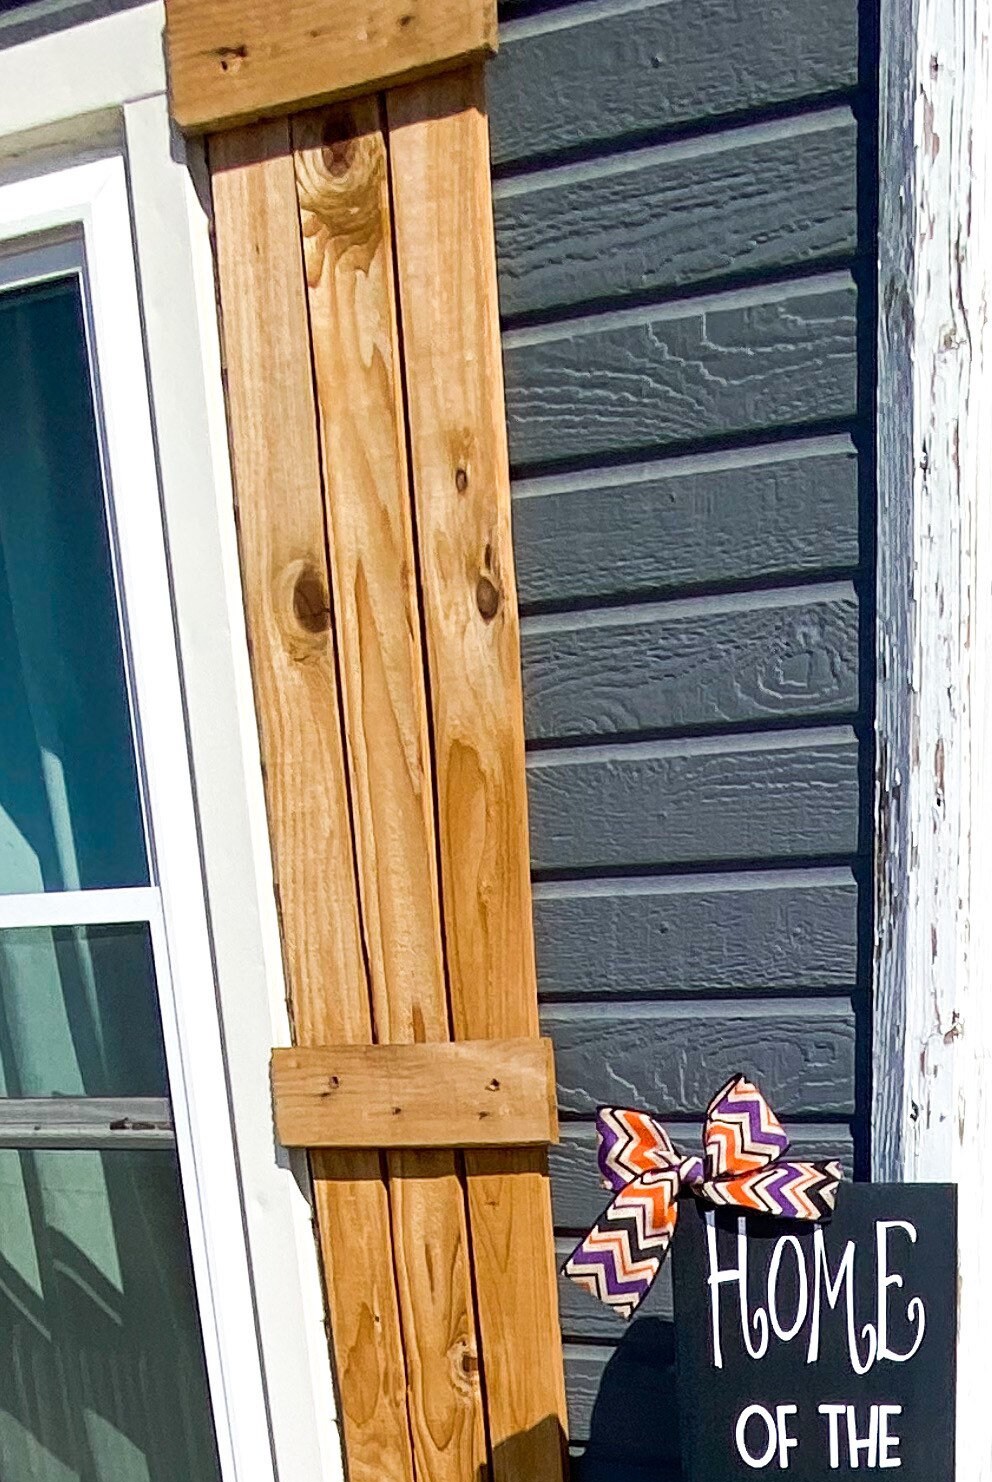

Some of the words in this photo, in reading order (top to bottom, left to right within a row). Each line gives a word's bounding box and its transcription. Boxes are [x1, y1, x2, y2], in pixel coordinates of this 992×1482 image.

[707, 1211, 926, 1375] HOME
[735, 1403, 798, 1469] OF
[817, 1403, 902, 1469] THE
